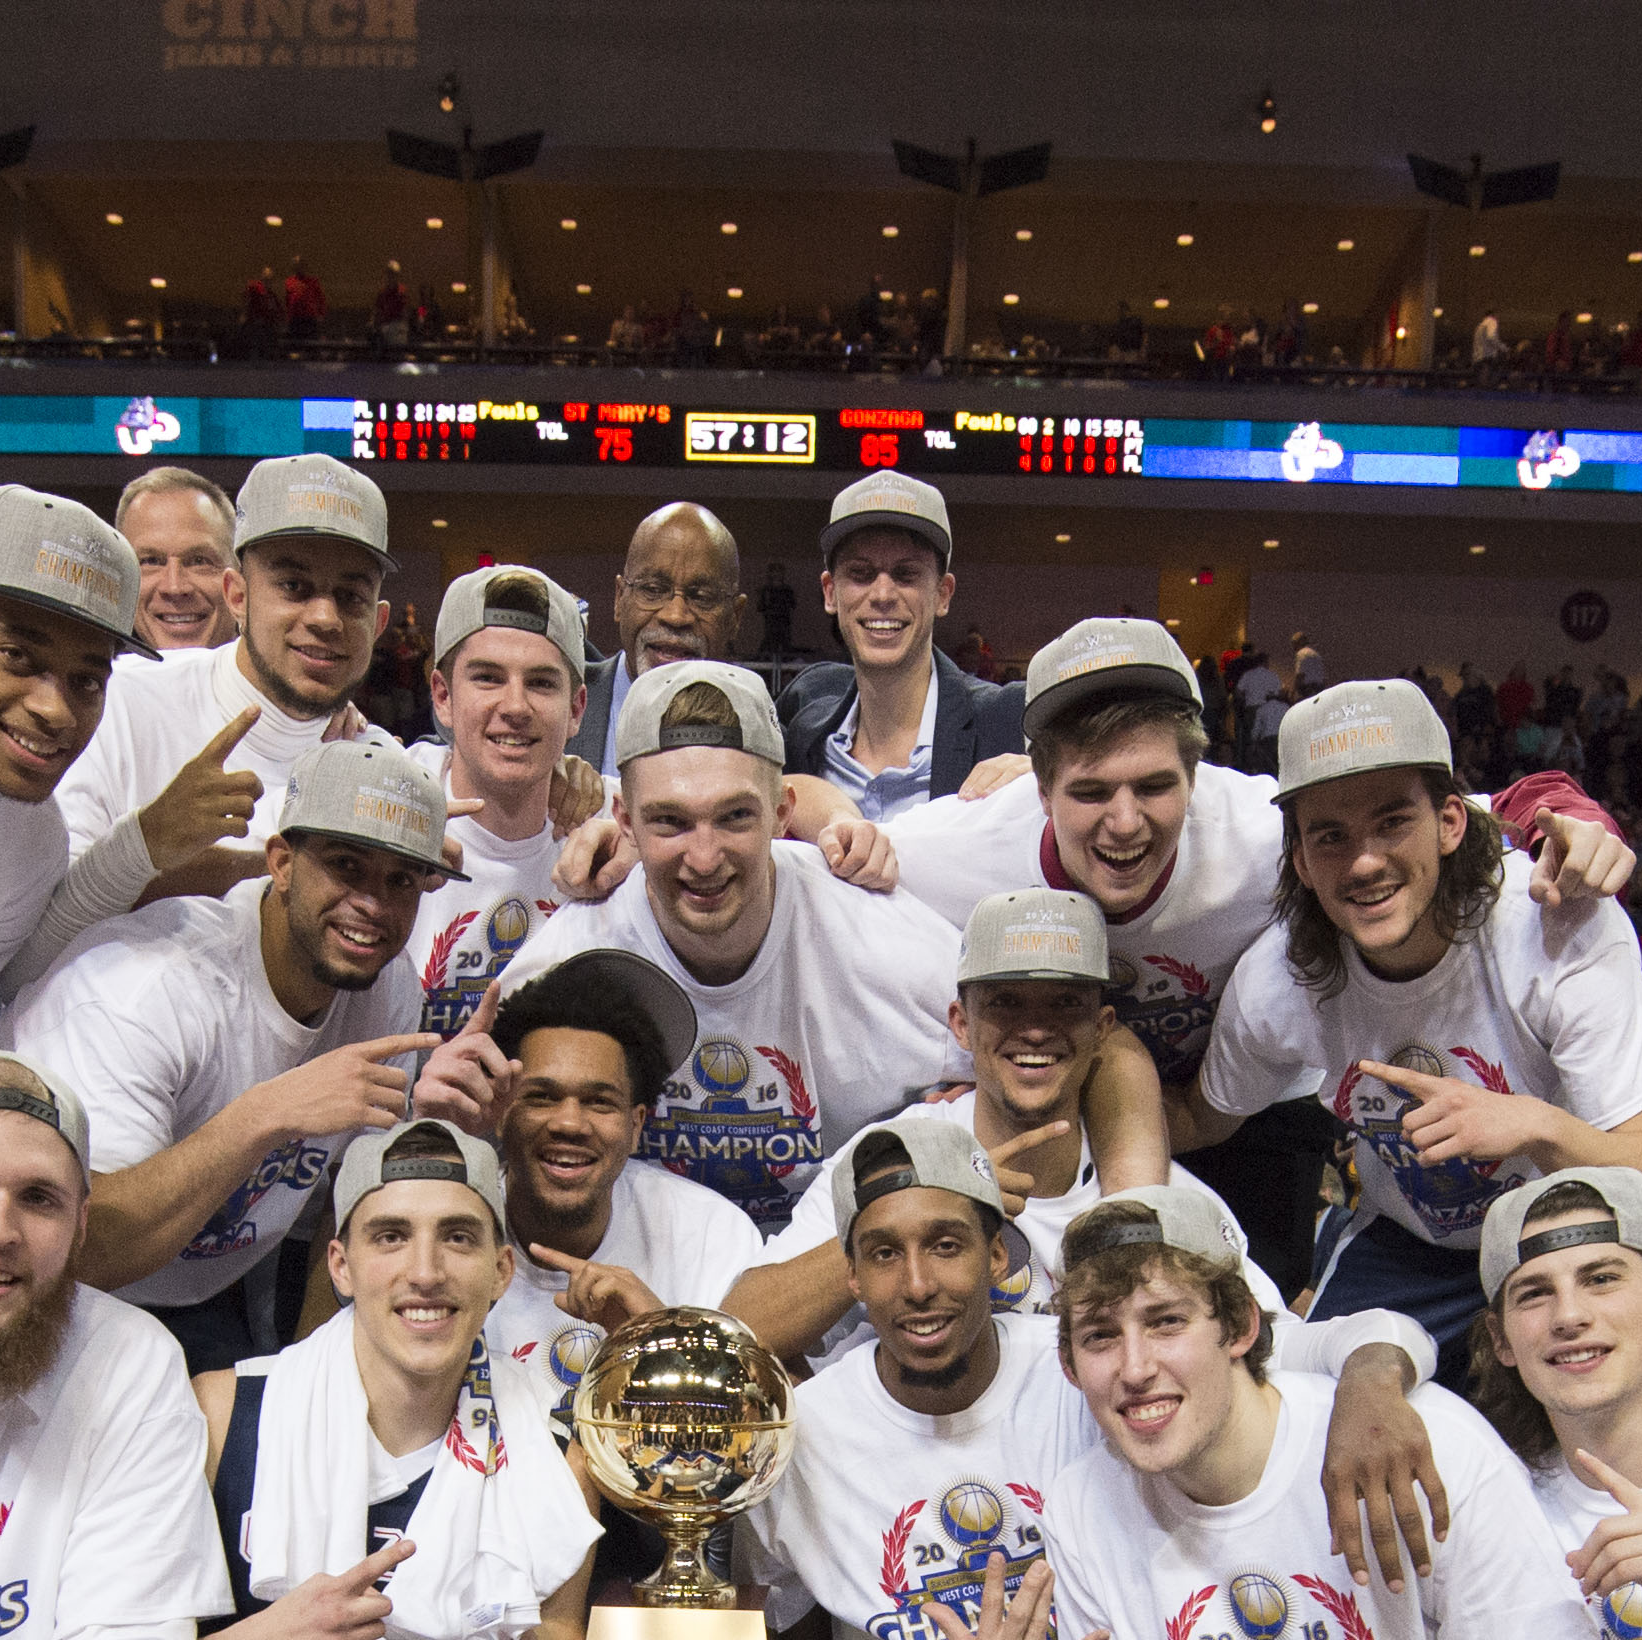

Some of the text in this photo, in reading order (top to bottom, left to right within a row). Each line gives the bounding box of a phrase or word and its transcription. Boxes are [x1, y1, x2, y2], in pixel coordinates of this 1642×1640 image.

[478, 401, 539, 420] Fouls
[564, 402, 671, 424] ST MARY'S
[839, 408, 924, 429] GONZAGA
[955, 411, 1016, 432] Fouls
[594, 427, 633, 462] 75
[691, 421, 807, 452] 57:12
[860, 433, 899, 467] 85
[456, 951, 483, 969] 20
[665, 1081, 778, 1103] 20 16
[1359, 1096, 1385, 1111] 20
[700, 1125, 726, 1134] COAST
[728, 1124, 775, 1135] CONFERENCE
[640, 1131, 823, 1162] HAMPION
[914, 1525, 1042, 1566] 20 16
[938, 1584, 984, 1602] WEST COA
